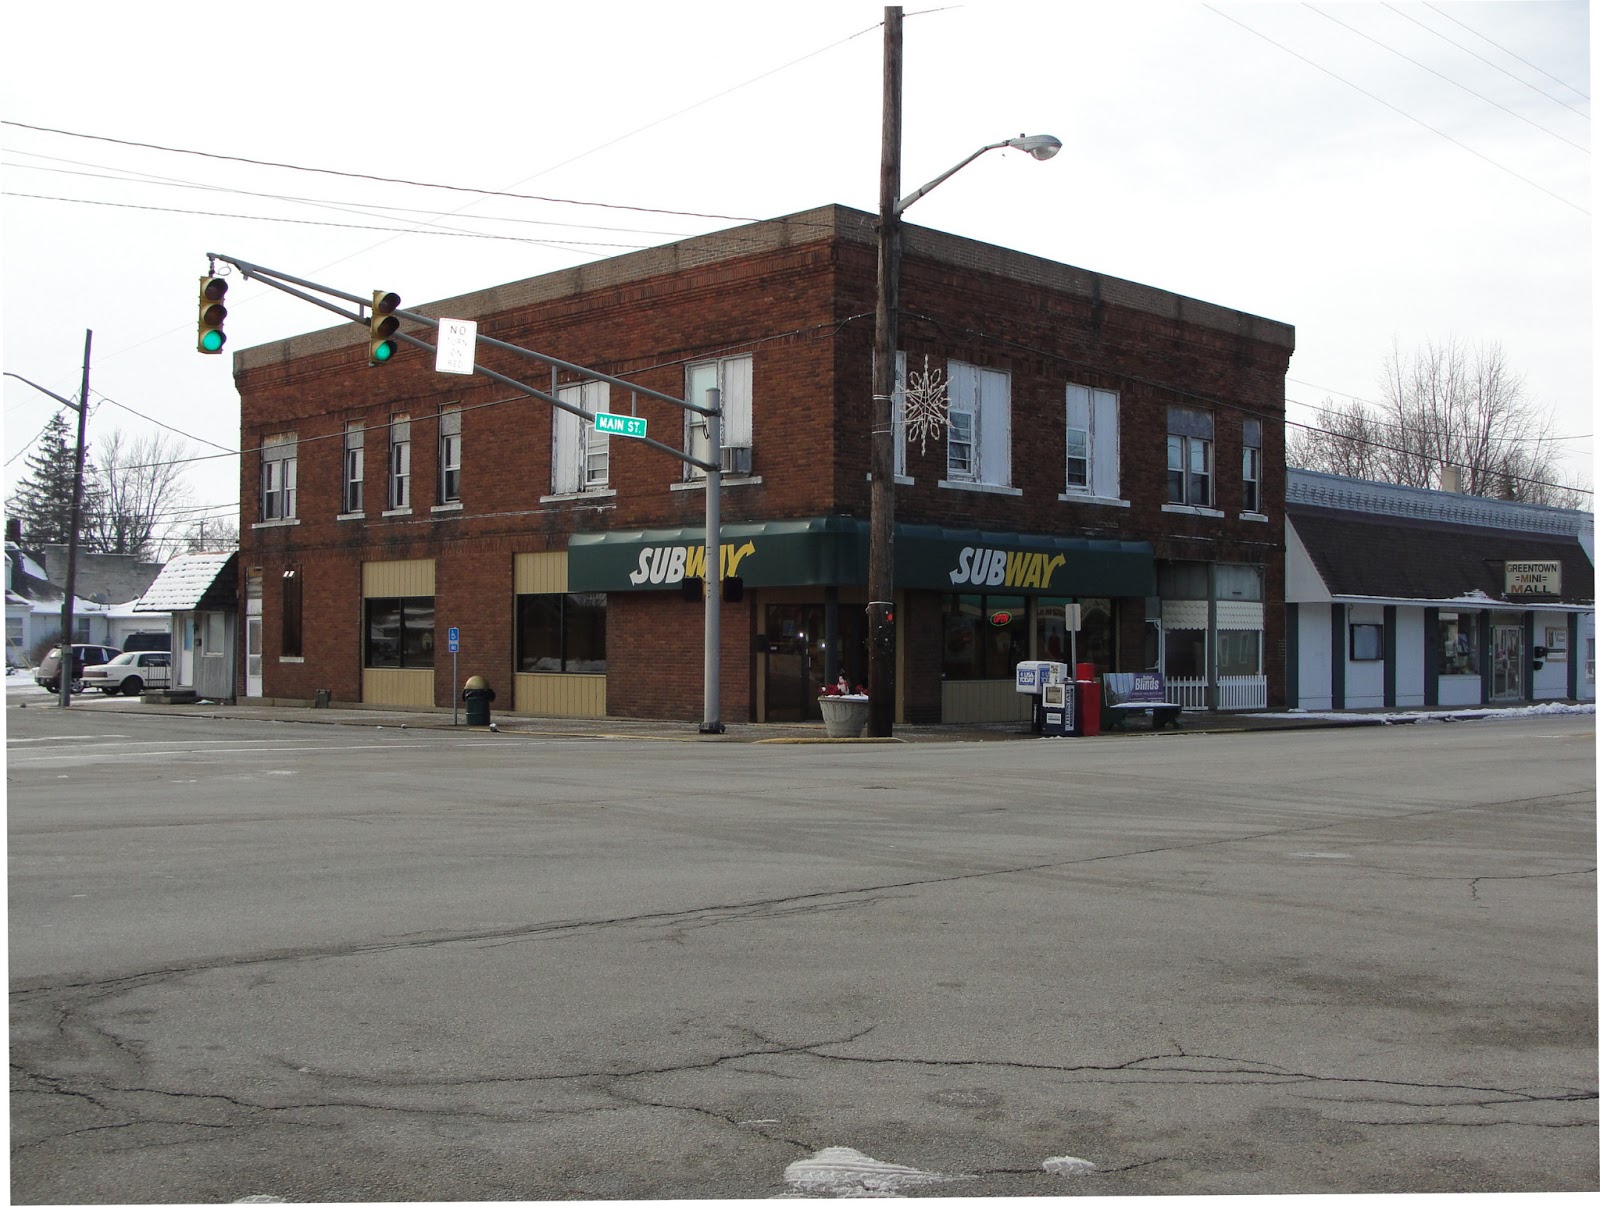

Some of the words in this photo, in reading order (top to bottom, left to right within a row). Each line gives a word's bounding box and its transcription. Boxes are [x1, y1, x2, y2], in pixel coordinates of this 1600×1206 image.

[449, 325, 467, 336] NO
[599, 416, 624, 431] MAIN
[627, 420, 642, 434] ST.
[629, 540, 756, 586] SUBWY
[949, 546, 1067, 589] SUBWAY
[1506, 563, 1558, 573] GREENTOWN
[1510, 584, 1552, 593] MALL
[1135, 677, 1160, 691] Blinds
